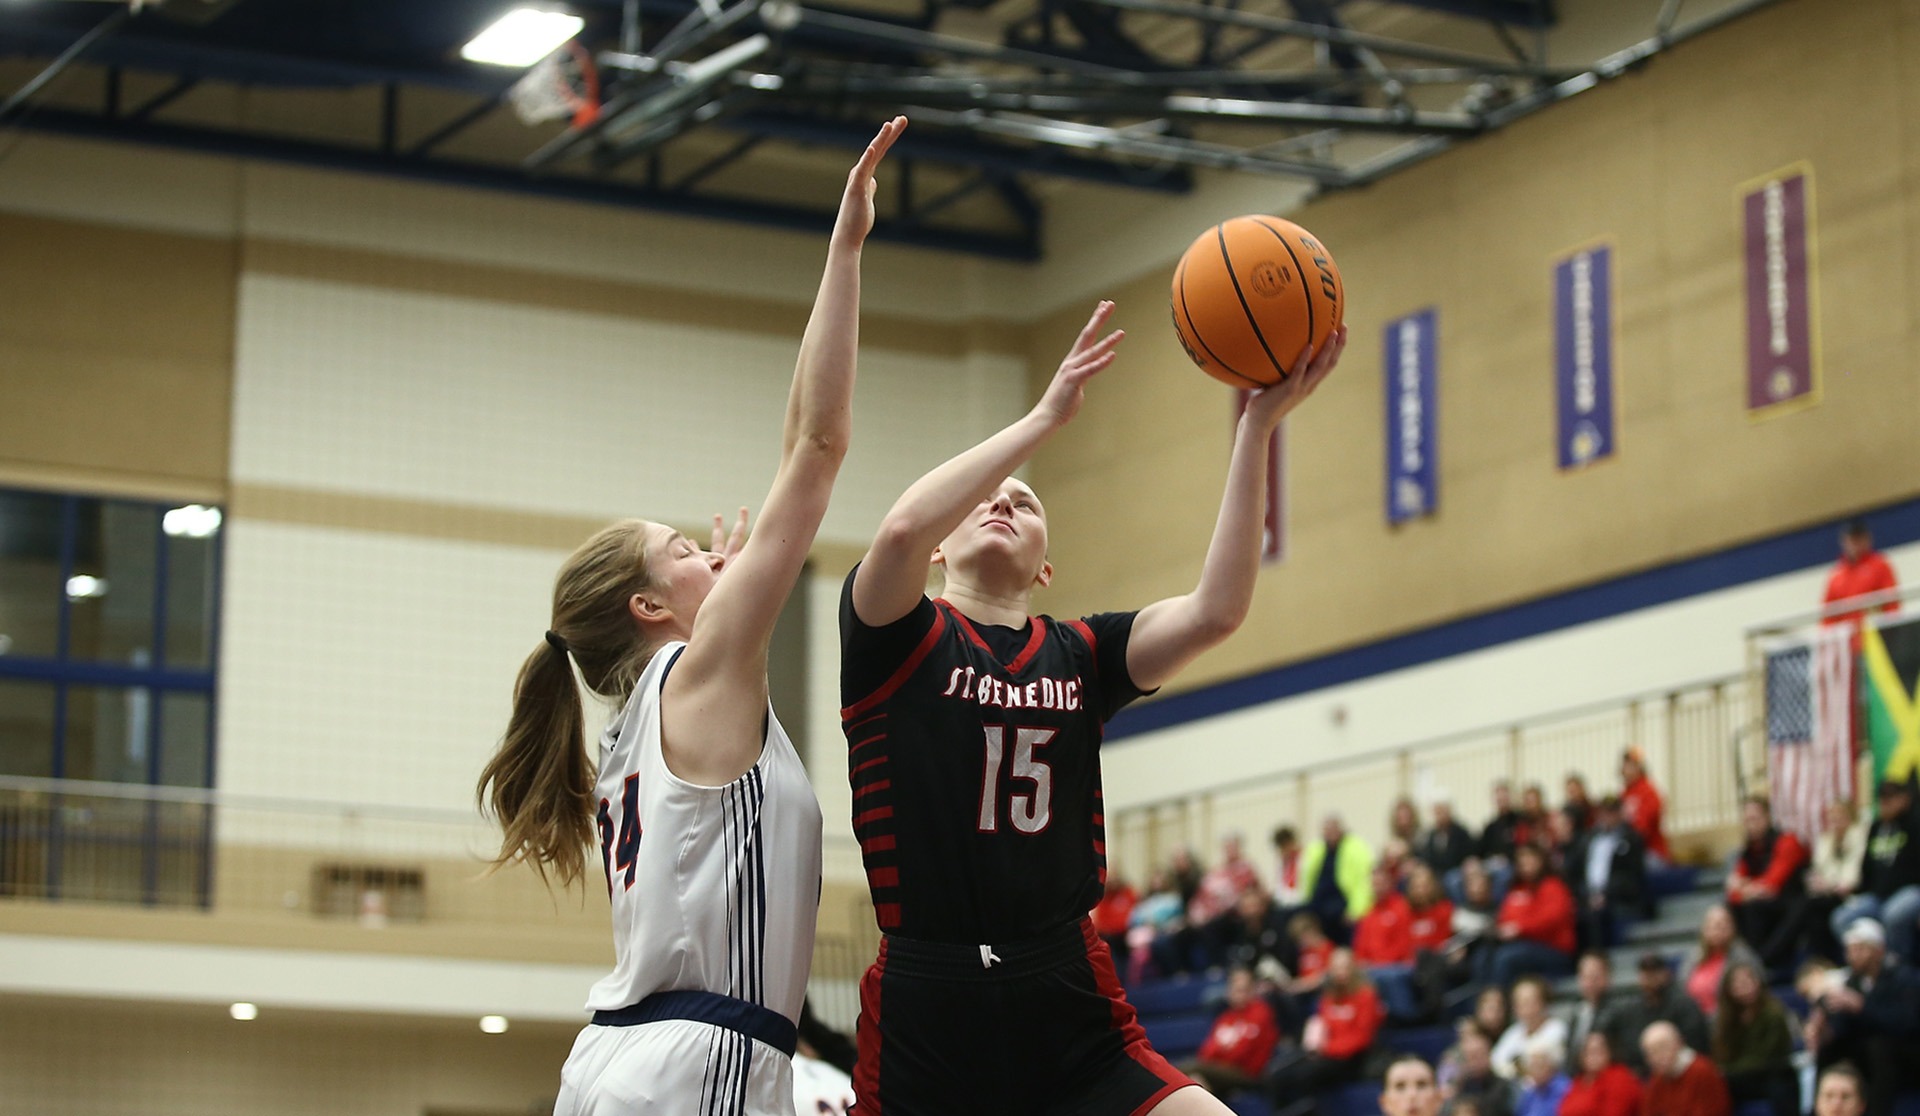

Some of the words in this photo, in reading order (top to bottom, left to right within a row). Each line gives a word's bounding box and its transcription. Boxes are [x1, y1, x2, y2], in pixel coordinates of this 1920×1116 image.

[1299, 235, 1337, 302] EVO
[977, 673, 1083, 712] BENEDIC
[977, 723, 1060, 835] 15
